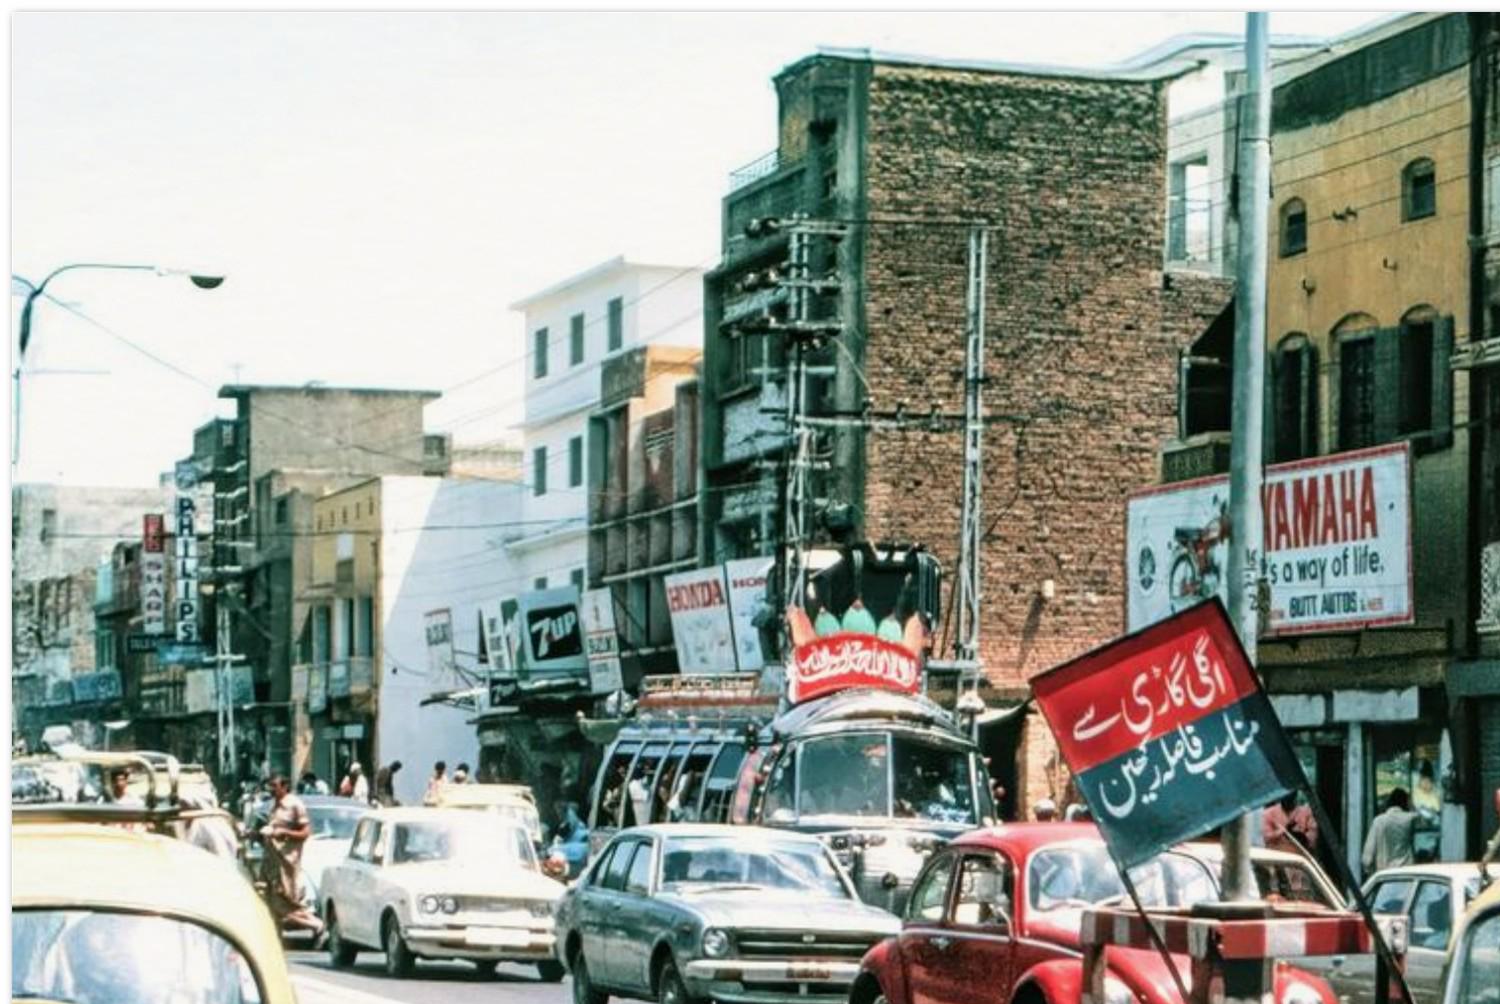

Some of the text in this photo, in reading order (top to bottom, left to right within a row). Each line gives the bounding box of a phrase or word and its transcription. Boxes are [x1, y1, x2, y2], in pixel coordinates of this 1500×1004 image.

[1260, 466, 1378, 553] YAMAHA
[178, 498, 195, 641] PHILIPS
[669, 579, 725, 612] HONDA
[1283, 565, 1292, 583] a
[1296, 557, 1326, 588] way
[1331, 547, 1350, 578] of
[1289, 594, 1318, 619] BUTT
[1073, 629, 1226, 741] اگلی گاڑی سے
[1184, 711, 1260, 780] مناسب
